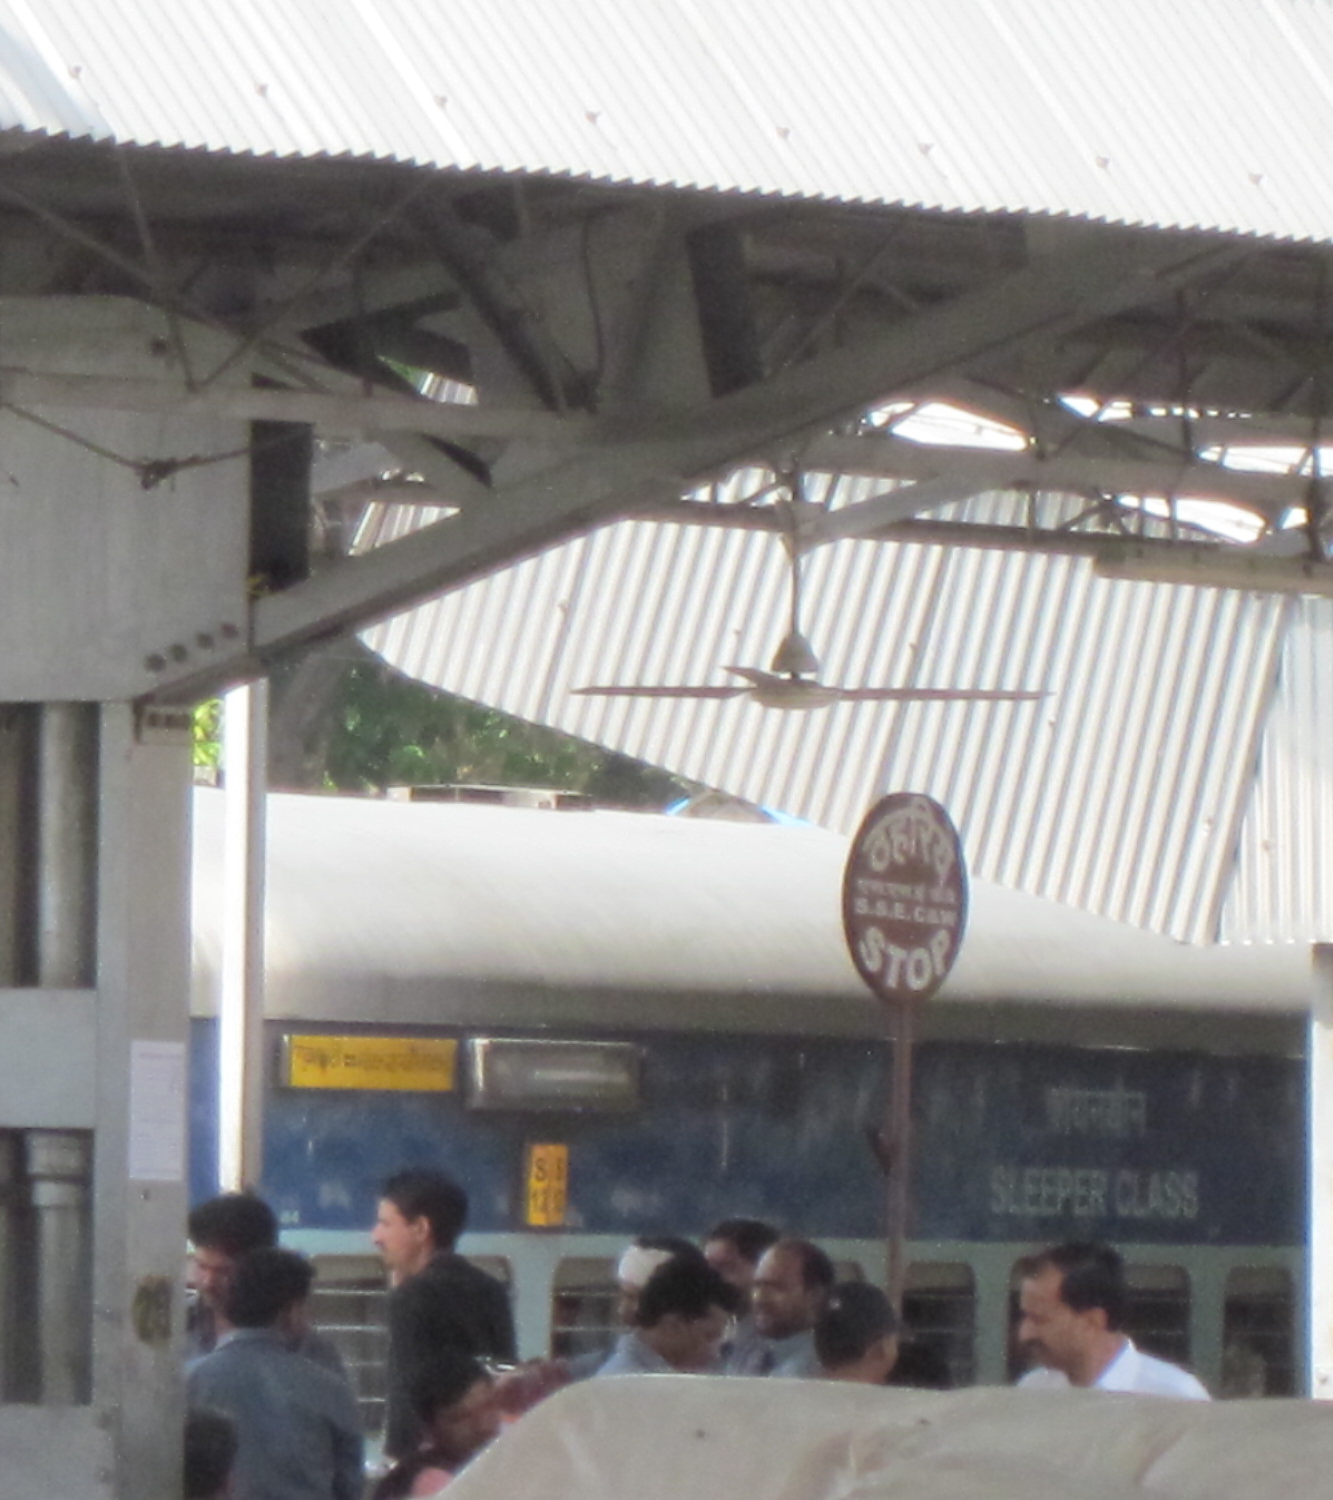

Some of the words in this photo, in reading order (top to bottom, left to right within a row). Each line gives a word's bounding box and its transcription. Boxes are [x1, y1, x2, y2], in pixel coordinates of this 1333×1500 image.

[858, 924, 950, 991] STOP
[990, 1165, 1108, 1218] SLEEPER
[1115, 1168, 1199, 1220] CLASS
